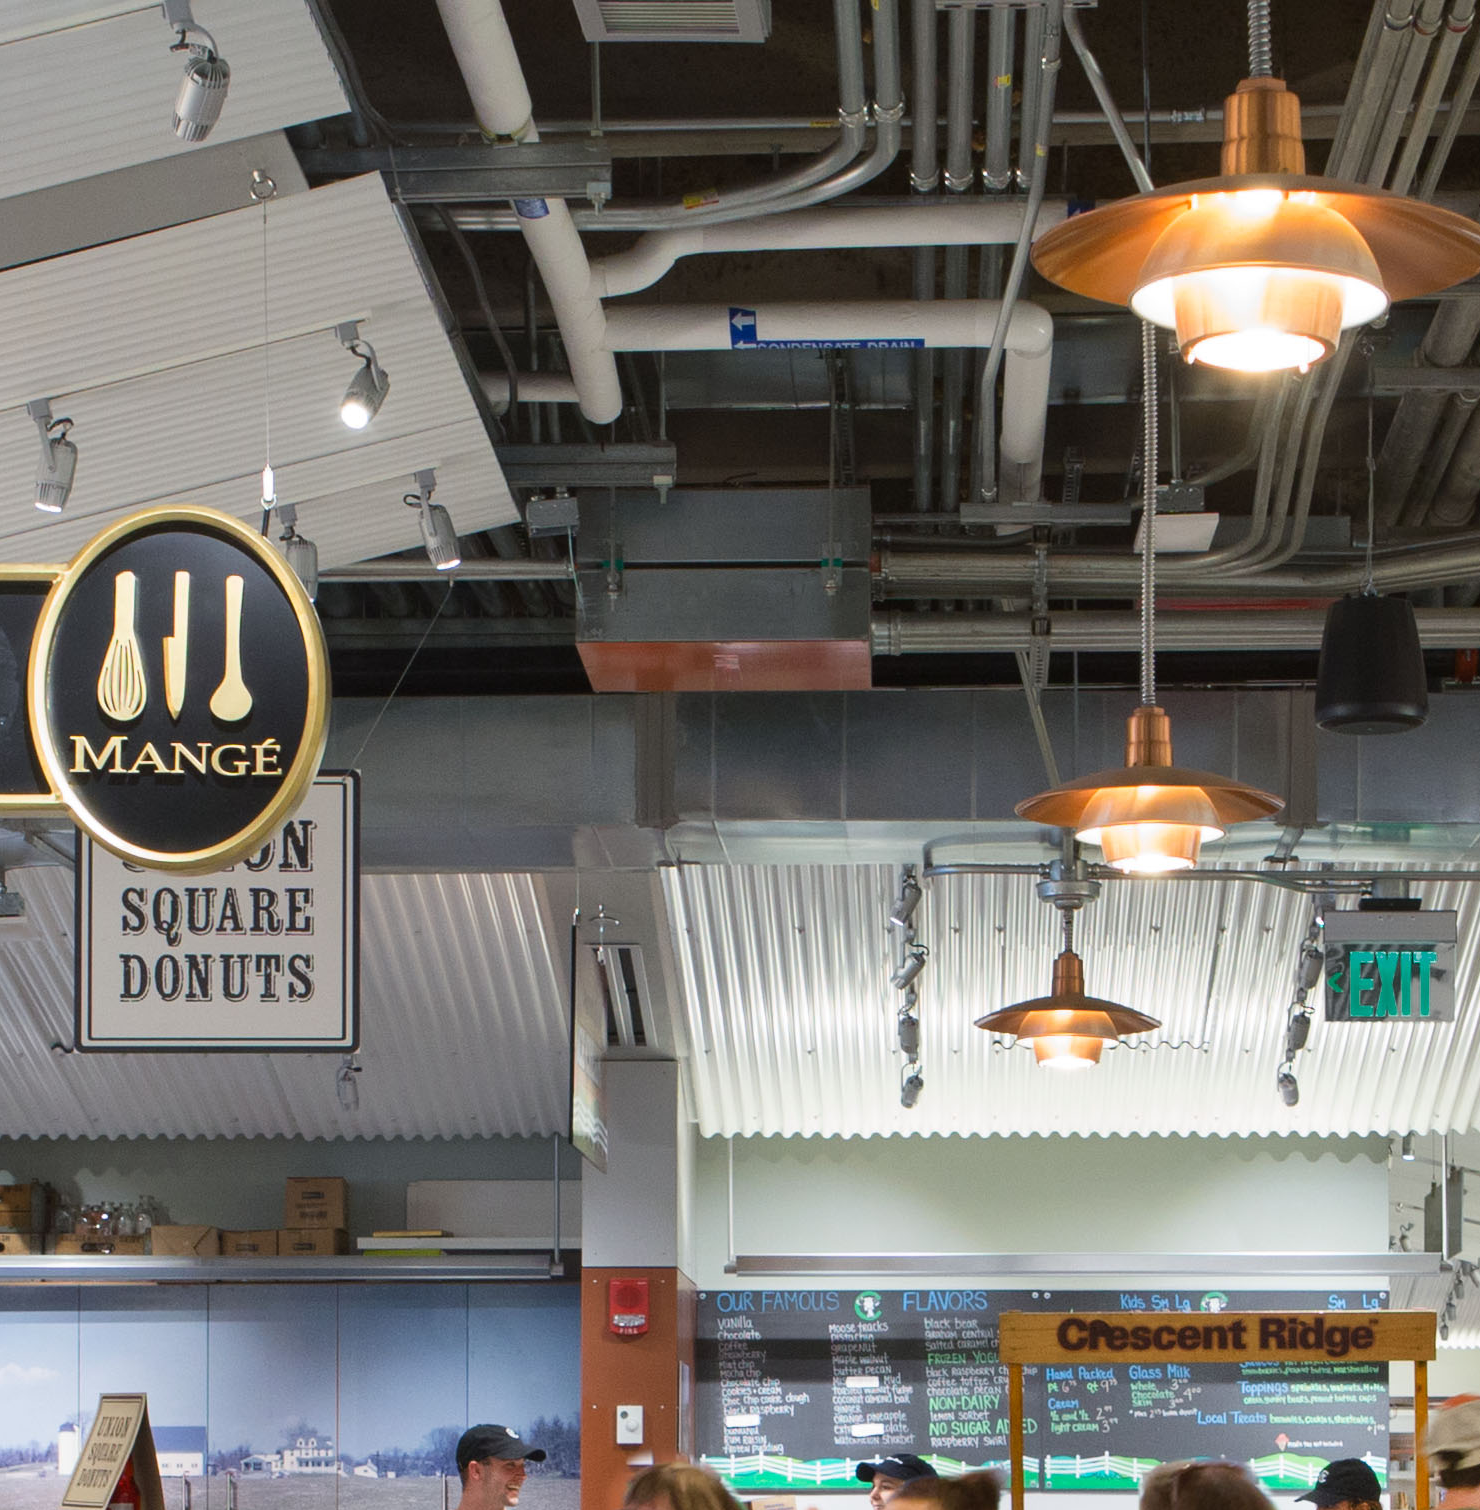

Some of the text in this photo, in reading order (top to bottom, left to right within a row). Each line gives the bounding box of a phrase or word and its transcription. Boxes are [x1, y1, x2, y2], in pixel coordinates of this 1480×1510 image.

[68, 735, 282, 777] MANGÉ
[121, 887, 315, 946] SQUARE
[120, 952, 315, 1003] DONUTS
[1349, 950, 1437, 1017] EXIT
[716, 1290, 988, 1313] OUR FAMOUS FLAVORS
[1120, 1293, 1146, 1309] Kids
[1056, 1317, 1376, 1358] Crescent Ridge
[927, 1353, 967, 1365] FROZEN
[1046, 1366, 1114, 1381] Hand Packed
[1129, 1363, 1191, 1380] Glass Milk
[1236, 1381, 1289, 1396] Toppings
[929, 1394, 1000, 1411] NON-DAIRY
[97, 1416, 132, 1438] UNION
[885, 1421, 909, 1434] olate
[929, 1417, 1038, 1436] NO SUGAR ADED
[1197, 1411, 1227, 1425] Local
[1228, 1410, 1267, 1424] Treats
[87, 1442, 123, 1466] SQUARE
[76, 1468, 112, 1489] DONUTS
